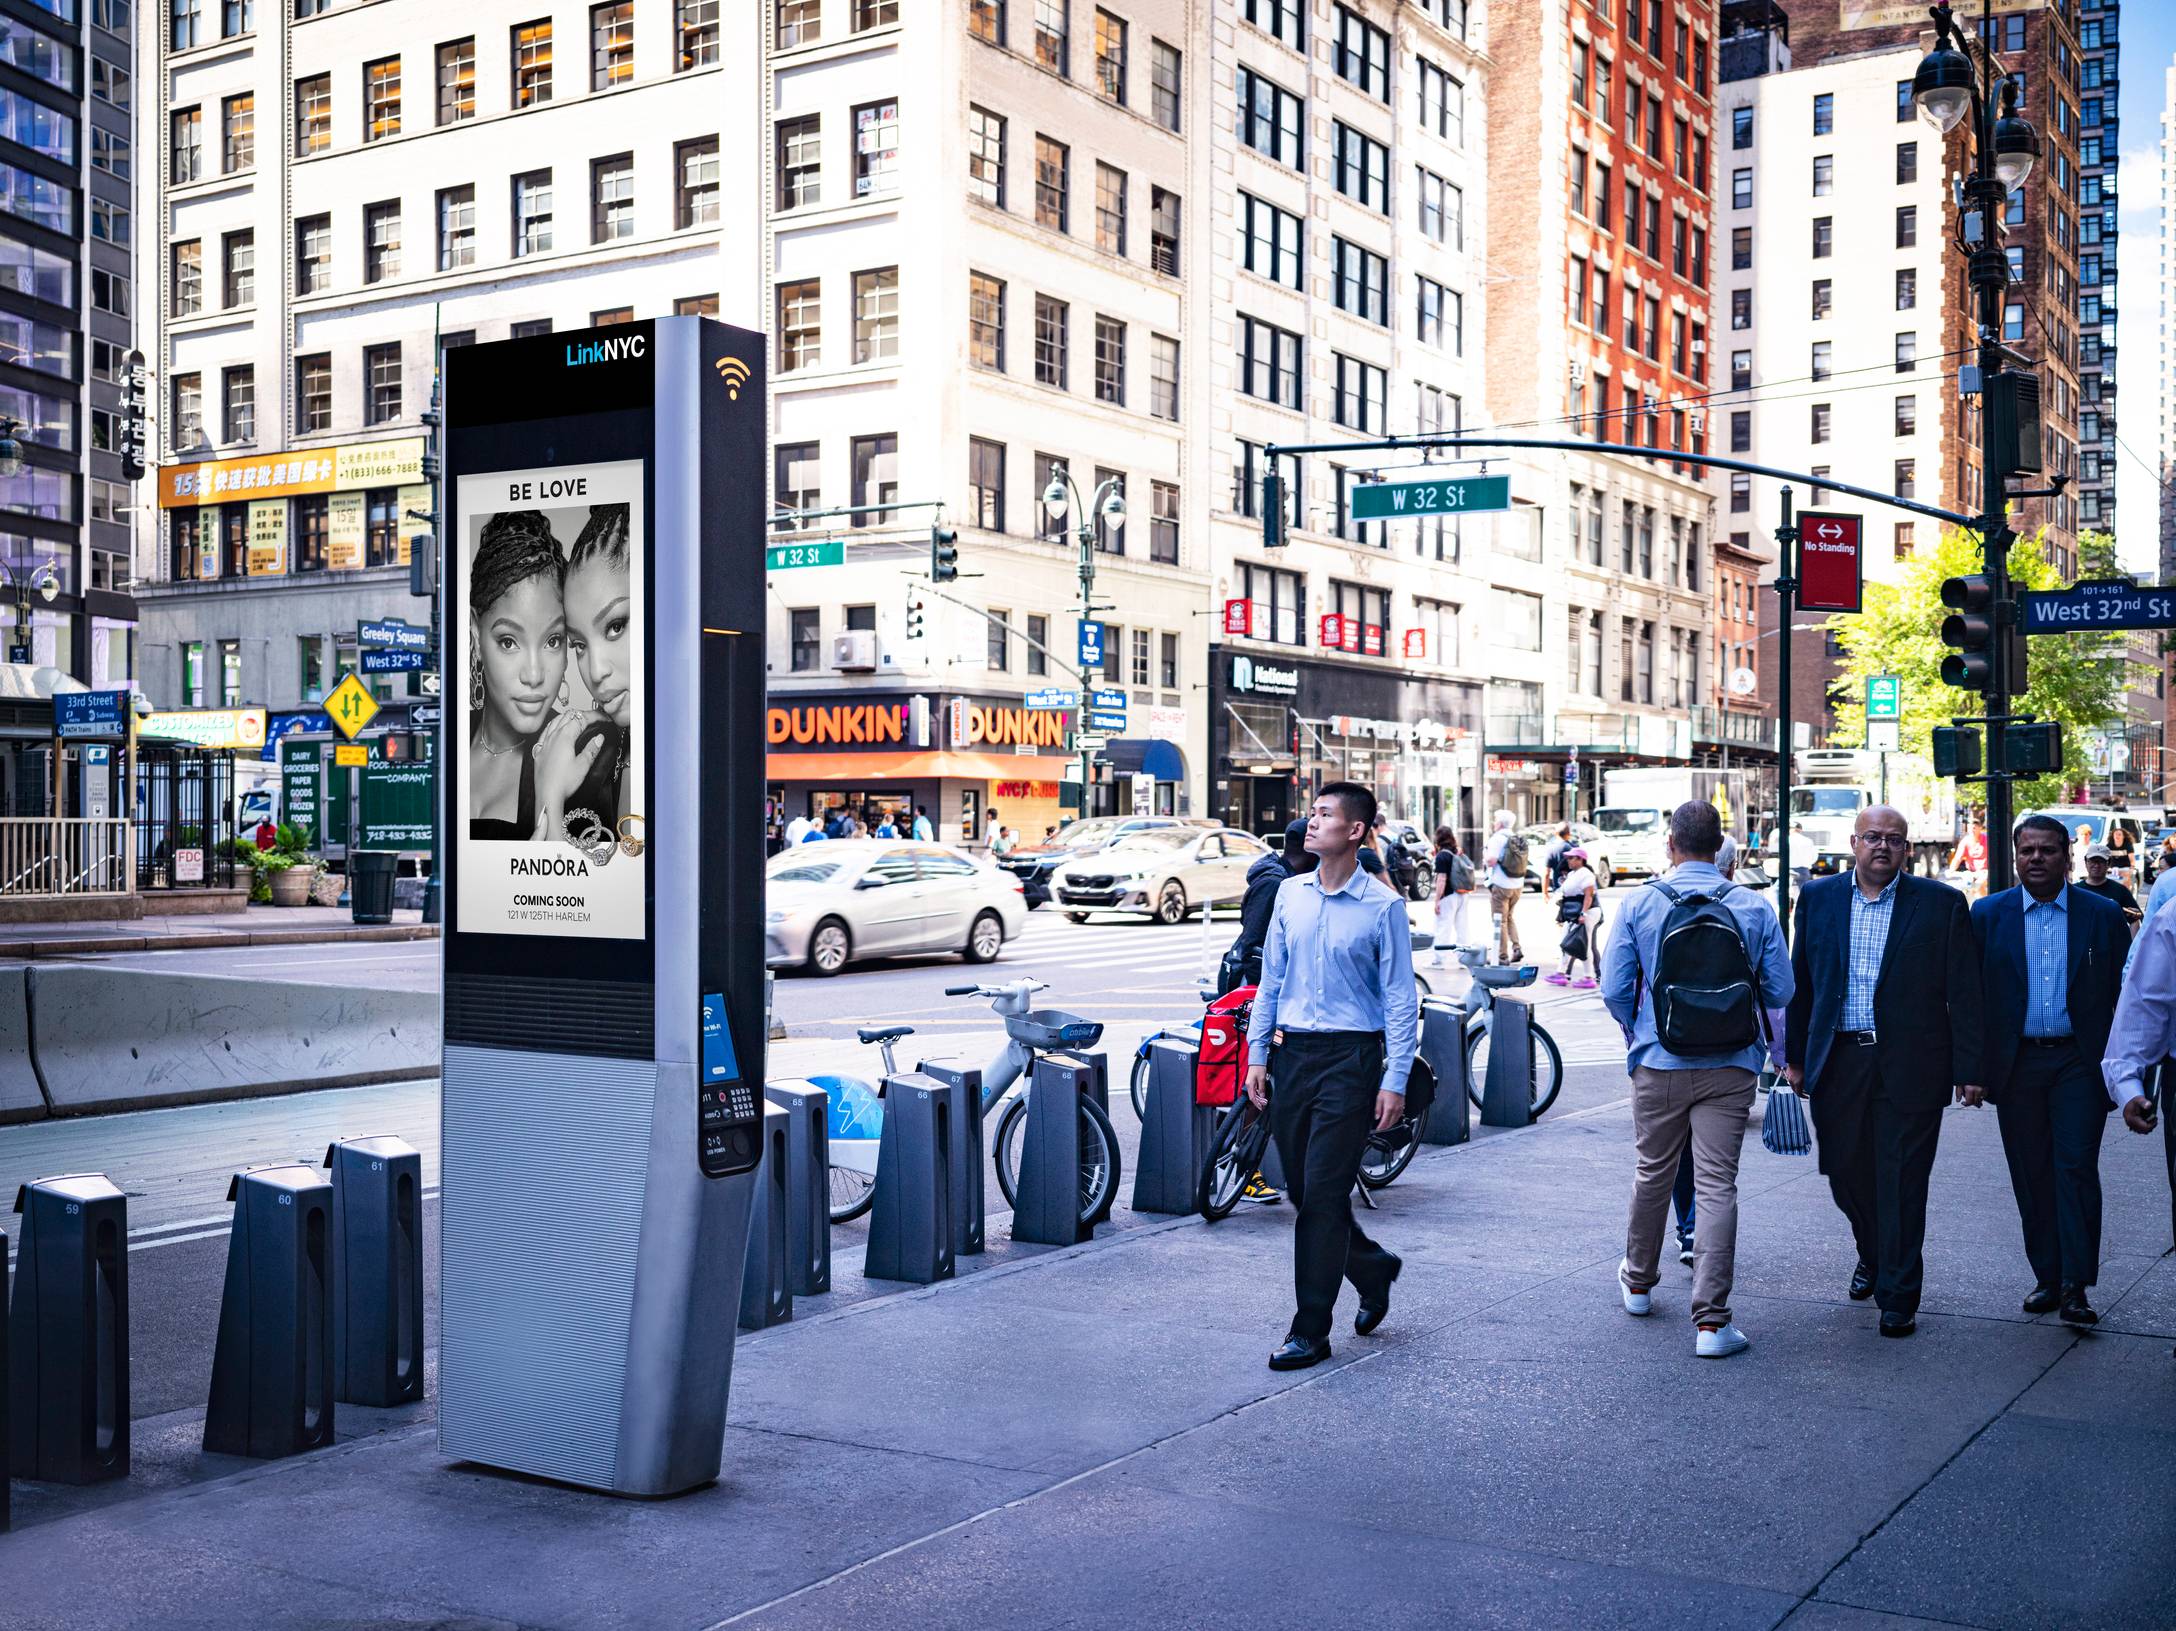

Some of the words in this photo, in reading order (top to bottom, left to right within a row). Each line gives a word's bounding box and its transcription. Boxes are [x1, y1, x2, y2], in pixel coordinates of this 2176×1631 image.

[566, 334, 645, 367] LinkNYC
[509, 482, 532, 501] BE
[539, 477, 588, 499] LOVE
[1392, 489, 1407, 511] W
[1414, 487, 1438, 509] 32
[1446, 485, 1466, 507] St
[1805, 541, 1817, 552] No
[1818, 541, 1856, 555] Standing
[777, 549, 786, 567] W
[789, 548, 804, 566] 32
[807, 547, 820, 564] St
[2082, 587, 2098, 595] 101
[2108, 585, 2123, 594] 161
[2035, 602, 2091, 621] West
[2097, 597, 2141, 620] 32nd
[2148, 598, 2171, 618] St
[361, 626, 395, 644] Greeley
[396, 629, 426, 645] Square
[366, 656, 389, 668] West
[392, 654, 410, 667] 32nd
[412, 655, 422, 666] St
[1255, 665, 1298, 687] National
[67, 697, 86, 708] 33rd
[88, 695, 113, 707] Street
[96, 710, 115, 719] Subway
[417, 710, 430, 718] ONE
[78, 725, 92, 733] Trains
[151, 715, 234, 731] CUSTOMIZED
[767, 704, 909, 744] DUNKIN'
[291, 751, 311, 761] DAIRY
[284, 763, 320, 774] GROCERIES
[291, 776, 312, 785] PAPER
[386, 774, 427, 786] COMPANY
[290, 788, 313, 798] GOODS
[997, 781, 1022, 798] NYC
[289, 801, 315, 811] FROZEN
[291, 814, 313, 823] FOODS
[178, 851, 201, 862] FDC
[510, 857, 589, 877] PANDORA
[513, 894, 554, 907] COMING
[556, 895, 585, 907] SOON
[507, 910, 519, 920] 121
[519, 911, 529, 920] W
[529, 911, 554, 921] 125TH
[556, 912, 591, 922] HARLEM
[1178, 1053, 1187, 1061] 70
[951, 1075, 961, 1083] 67
[917, 1091, 928, 1099] 66
[371, 1161, 383, 1172] 61
[278, 1194, 291, 1206] 60
[65, 1203, 79, 1216] 59
